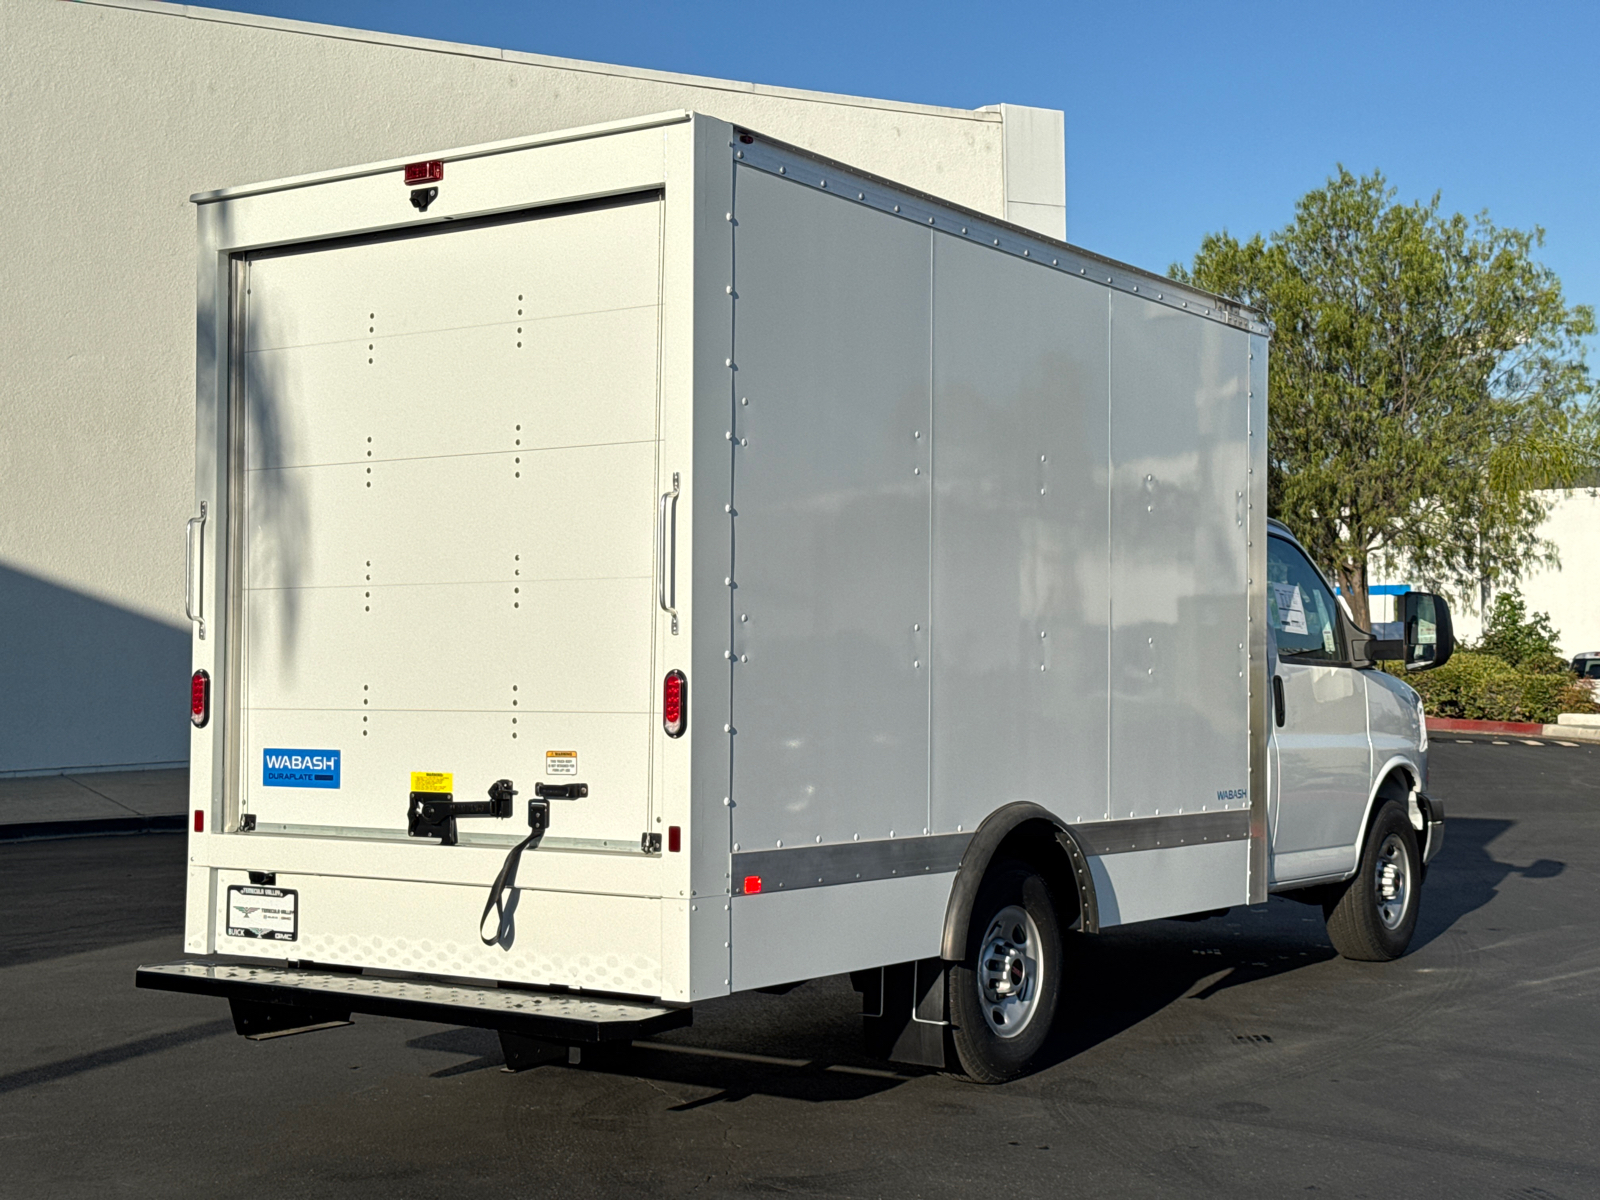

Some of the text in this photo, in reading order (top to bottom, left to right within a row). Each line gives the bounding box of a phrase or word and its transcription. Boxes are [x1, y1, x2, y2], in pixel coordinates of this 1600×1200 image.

[268, 772, 313, 781] DURAPLATE
[1217, 789, 1247, 800] WABASH
[228, 928, 245, 936] BUICK
